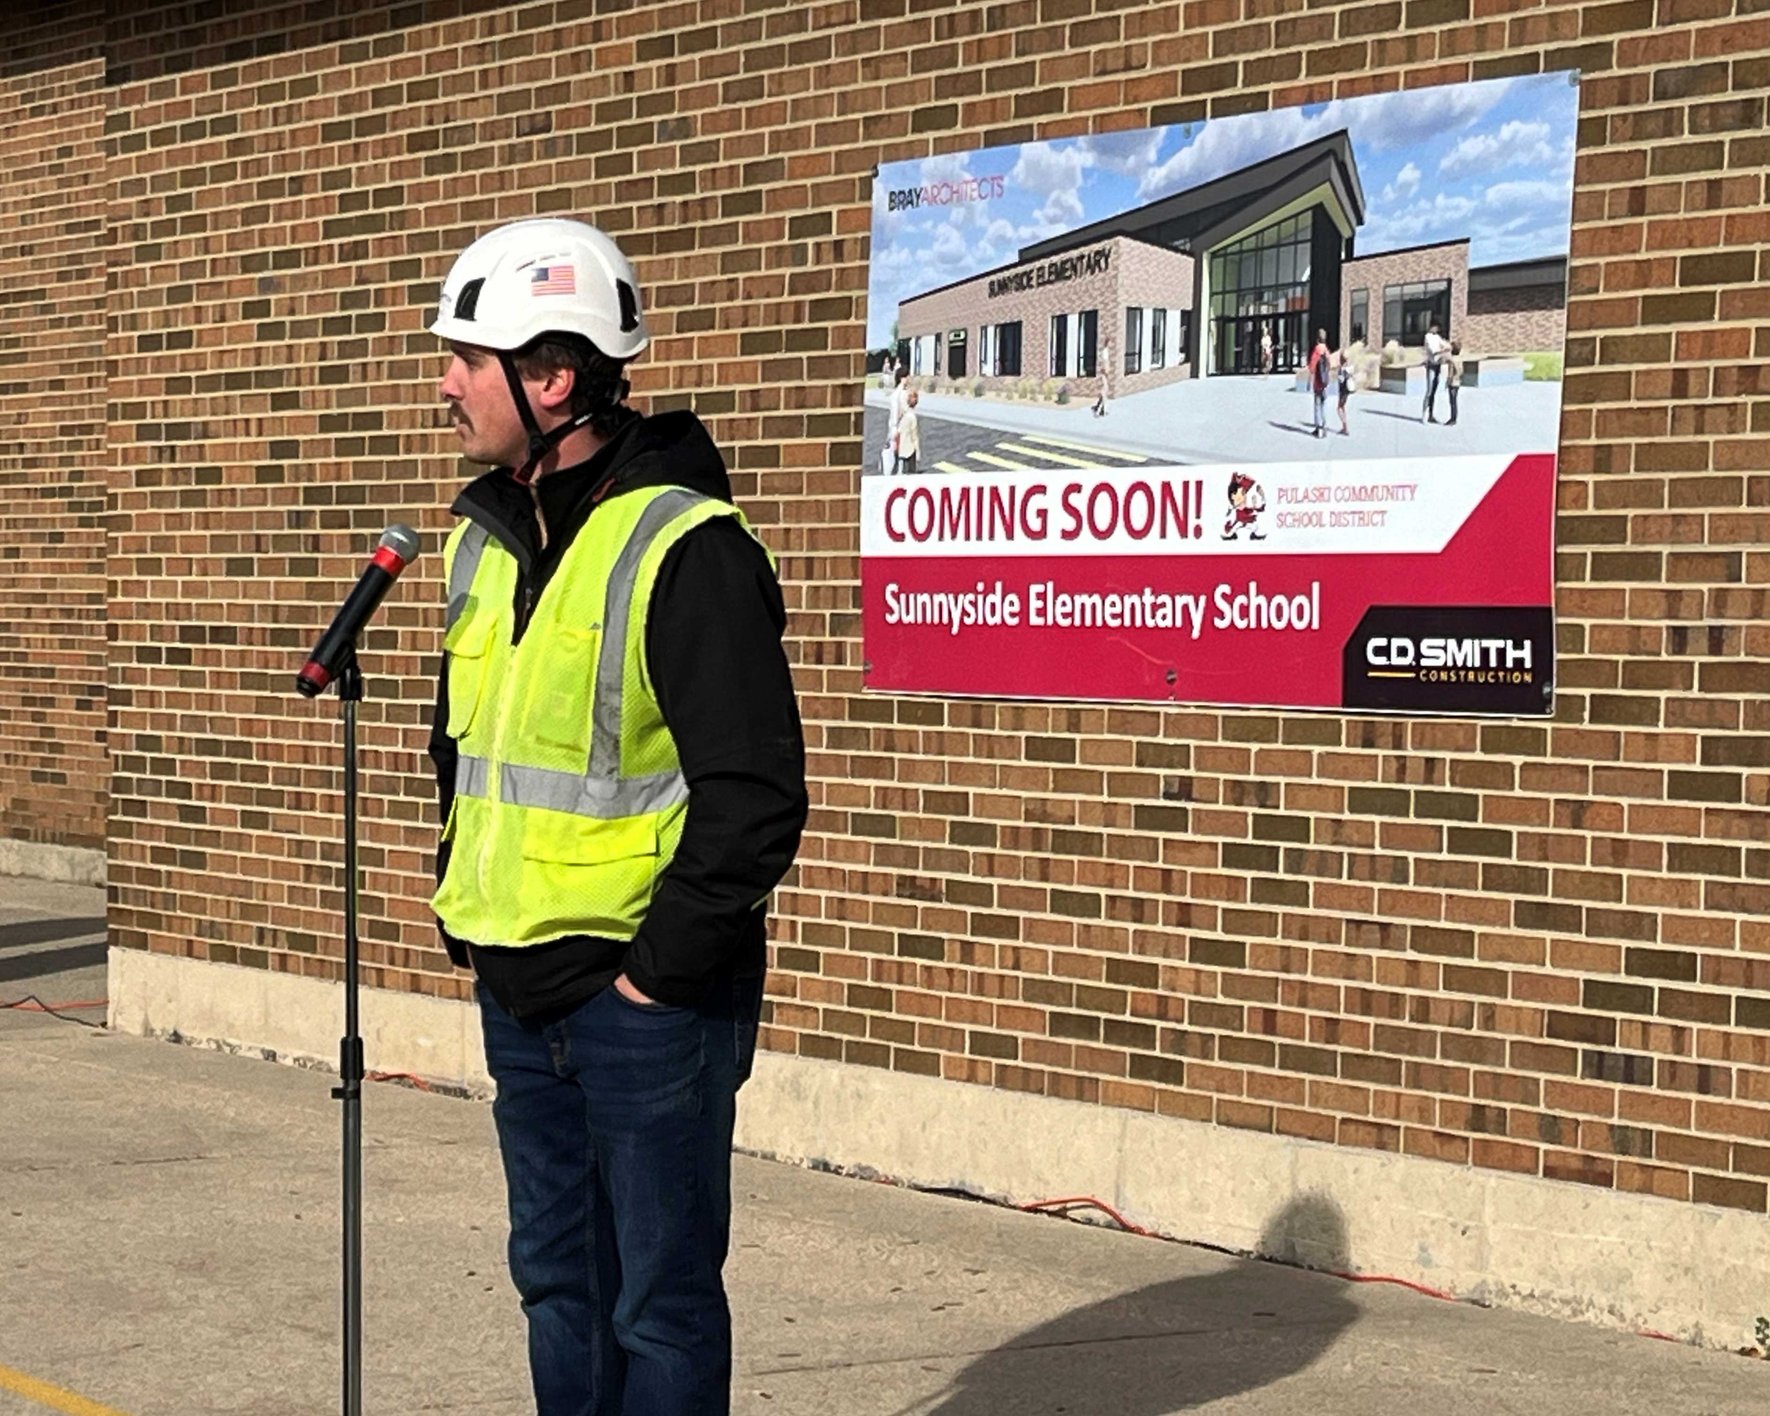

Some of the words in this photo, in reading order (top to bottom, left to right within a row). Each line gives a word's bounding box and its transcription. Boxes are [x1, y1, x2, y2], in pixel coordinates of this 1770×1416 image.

[1036, 248, 1111, 287] ELEMENTARY
[1277, 486, 1331, 503] PULASKI
[1334, 484, 1418, 502] COMMUNITY
[885, 485, 1048, 542] COMING
[1060, 480, 1203, 541] SOON!
[1276, 511, 1326, 528] SCHOOL
[1329, 510, 1388, 527] DISTRICT
[885, 582, 1020, 635] Sunnyside
[1029, 582, 1206, 639] Elementary
[1213, 582, 1320, 630] School
[1419, 669, 1533, 684] CONSTRUCTION
